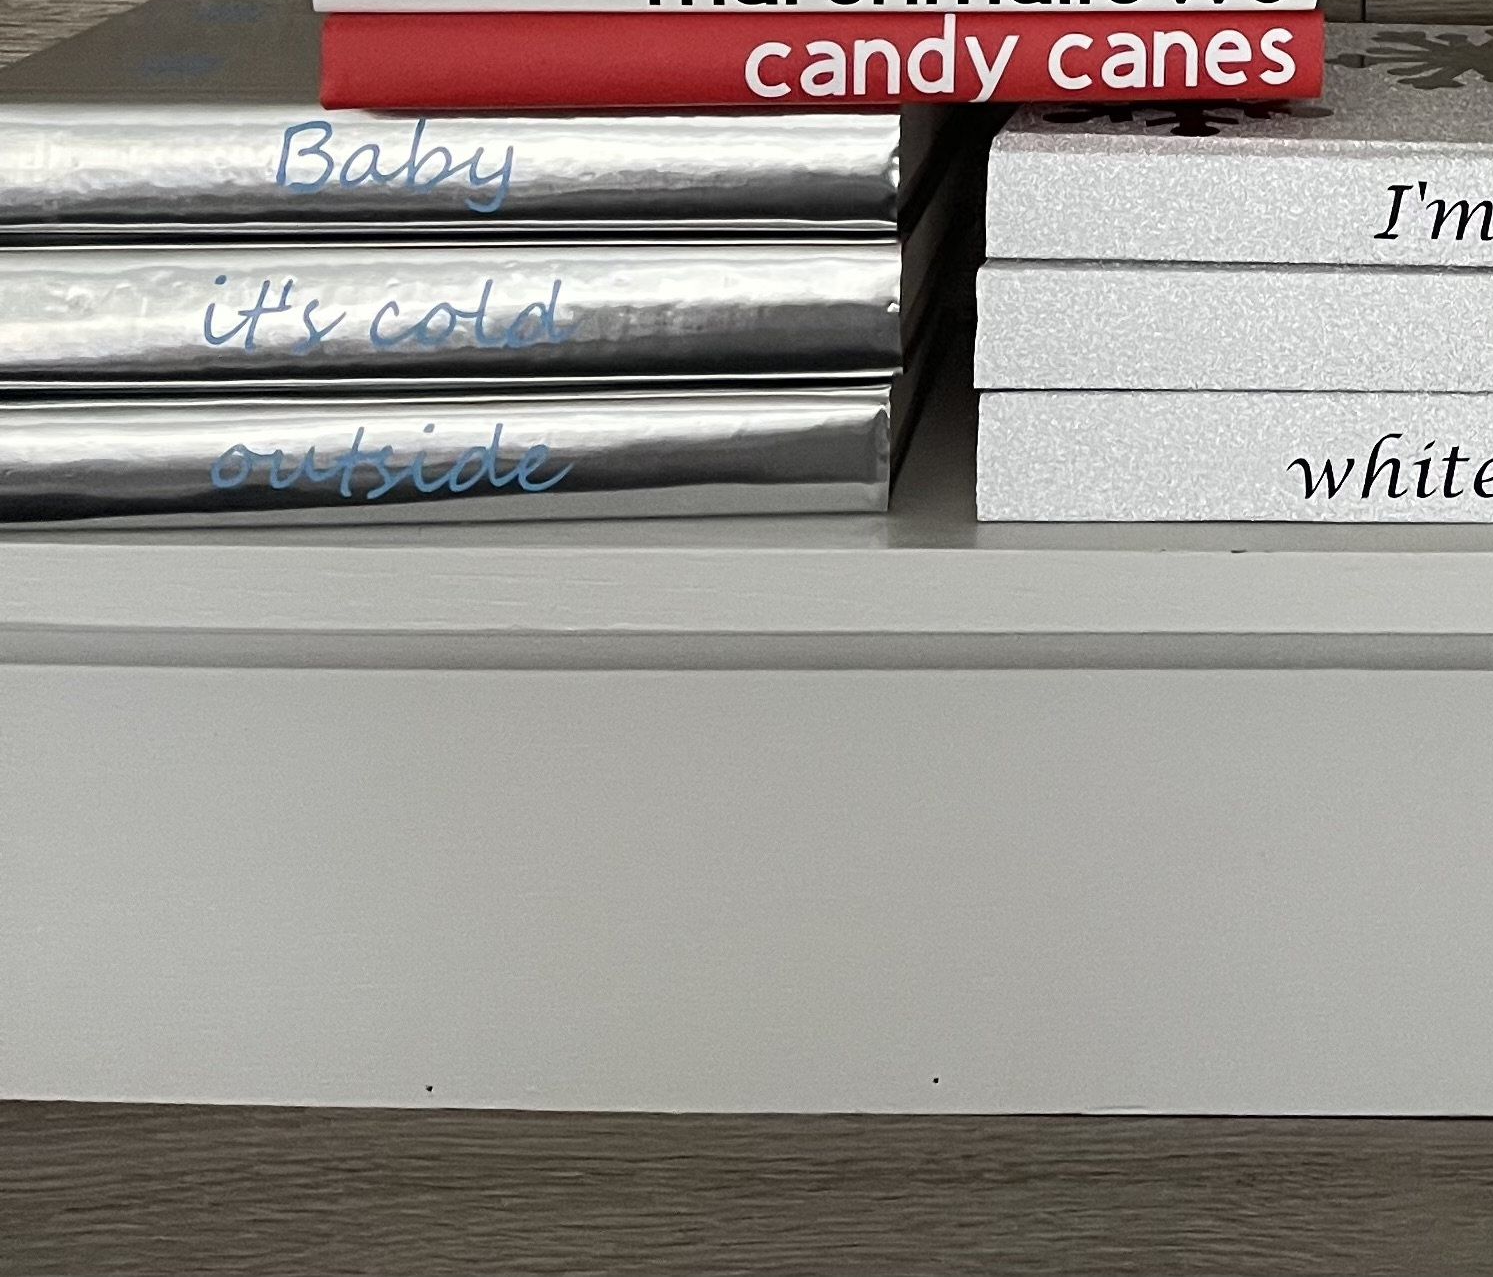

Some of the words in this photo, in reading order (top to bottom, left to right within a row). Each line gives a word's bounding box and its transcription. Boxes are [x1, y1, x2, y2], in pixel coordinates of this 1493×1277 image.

[744, 13, 1020, 103] candy
[1047, 26, 1297, 91] canes
[275, 118, 515, 213] Baby
[203, 274, 347, 354] it's
[369, 278, 580, 350] cold
[209, 422, 577, 499] outside
